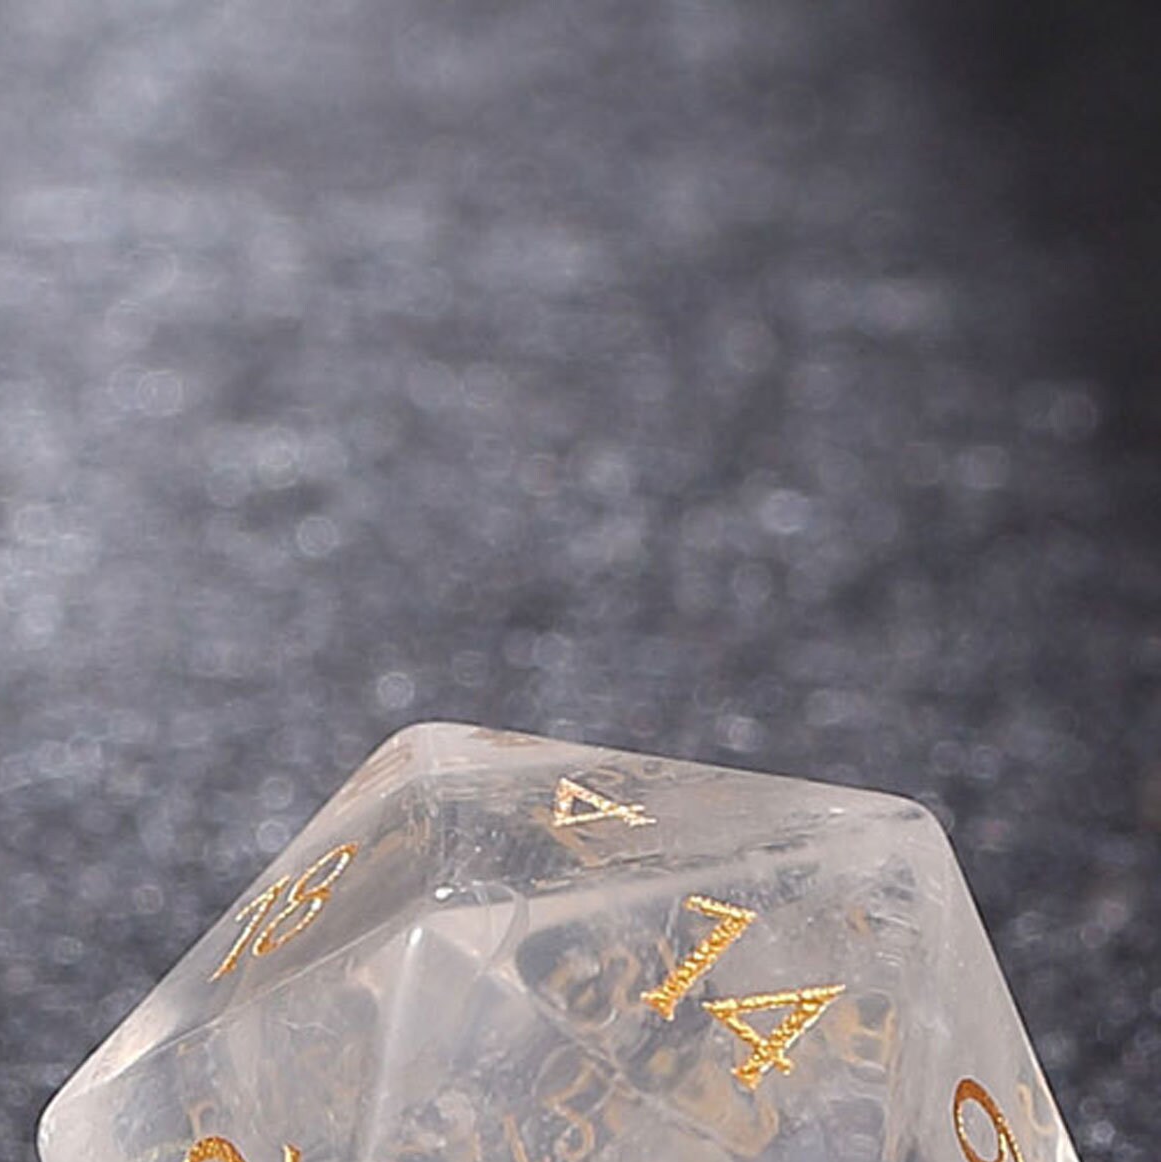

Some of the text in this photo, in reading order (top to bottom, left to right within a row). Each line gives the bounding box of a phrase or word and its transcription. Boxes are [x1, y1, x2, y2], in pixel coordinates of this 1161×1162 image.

[553, 777, 657, 827] 4
[208, 843, 358, 983] 18
[641, 894, 846, 1090] 14
